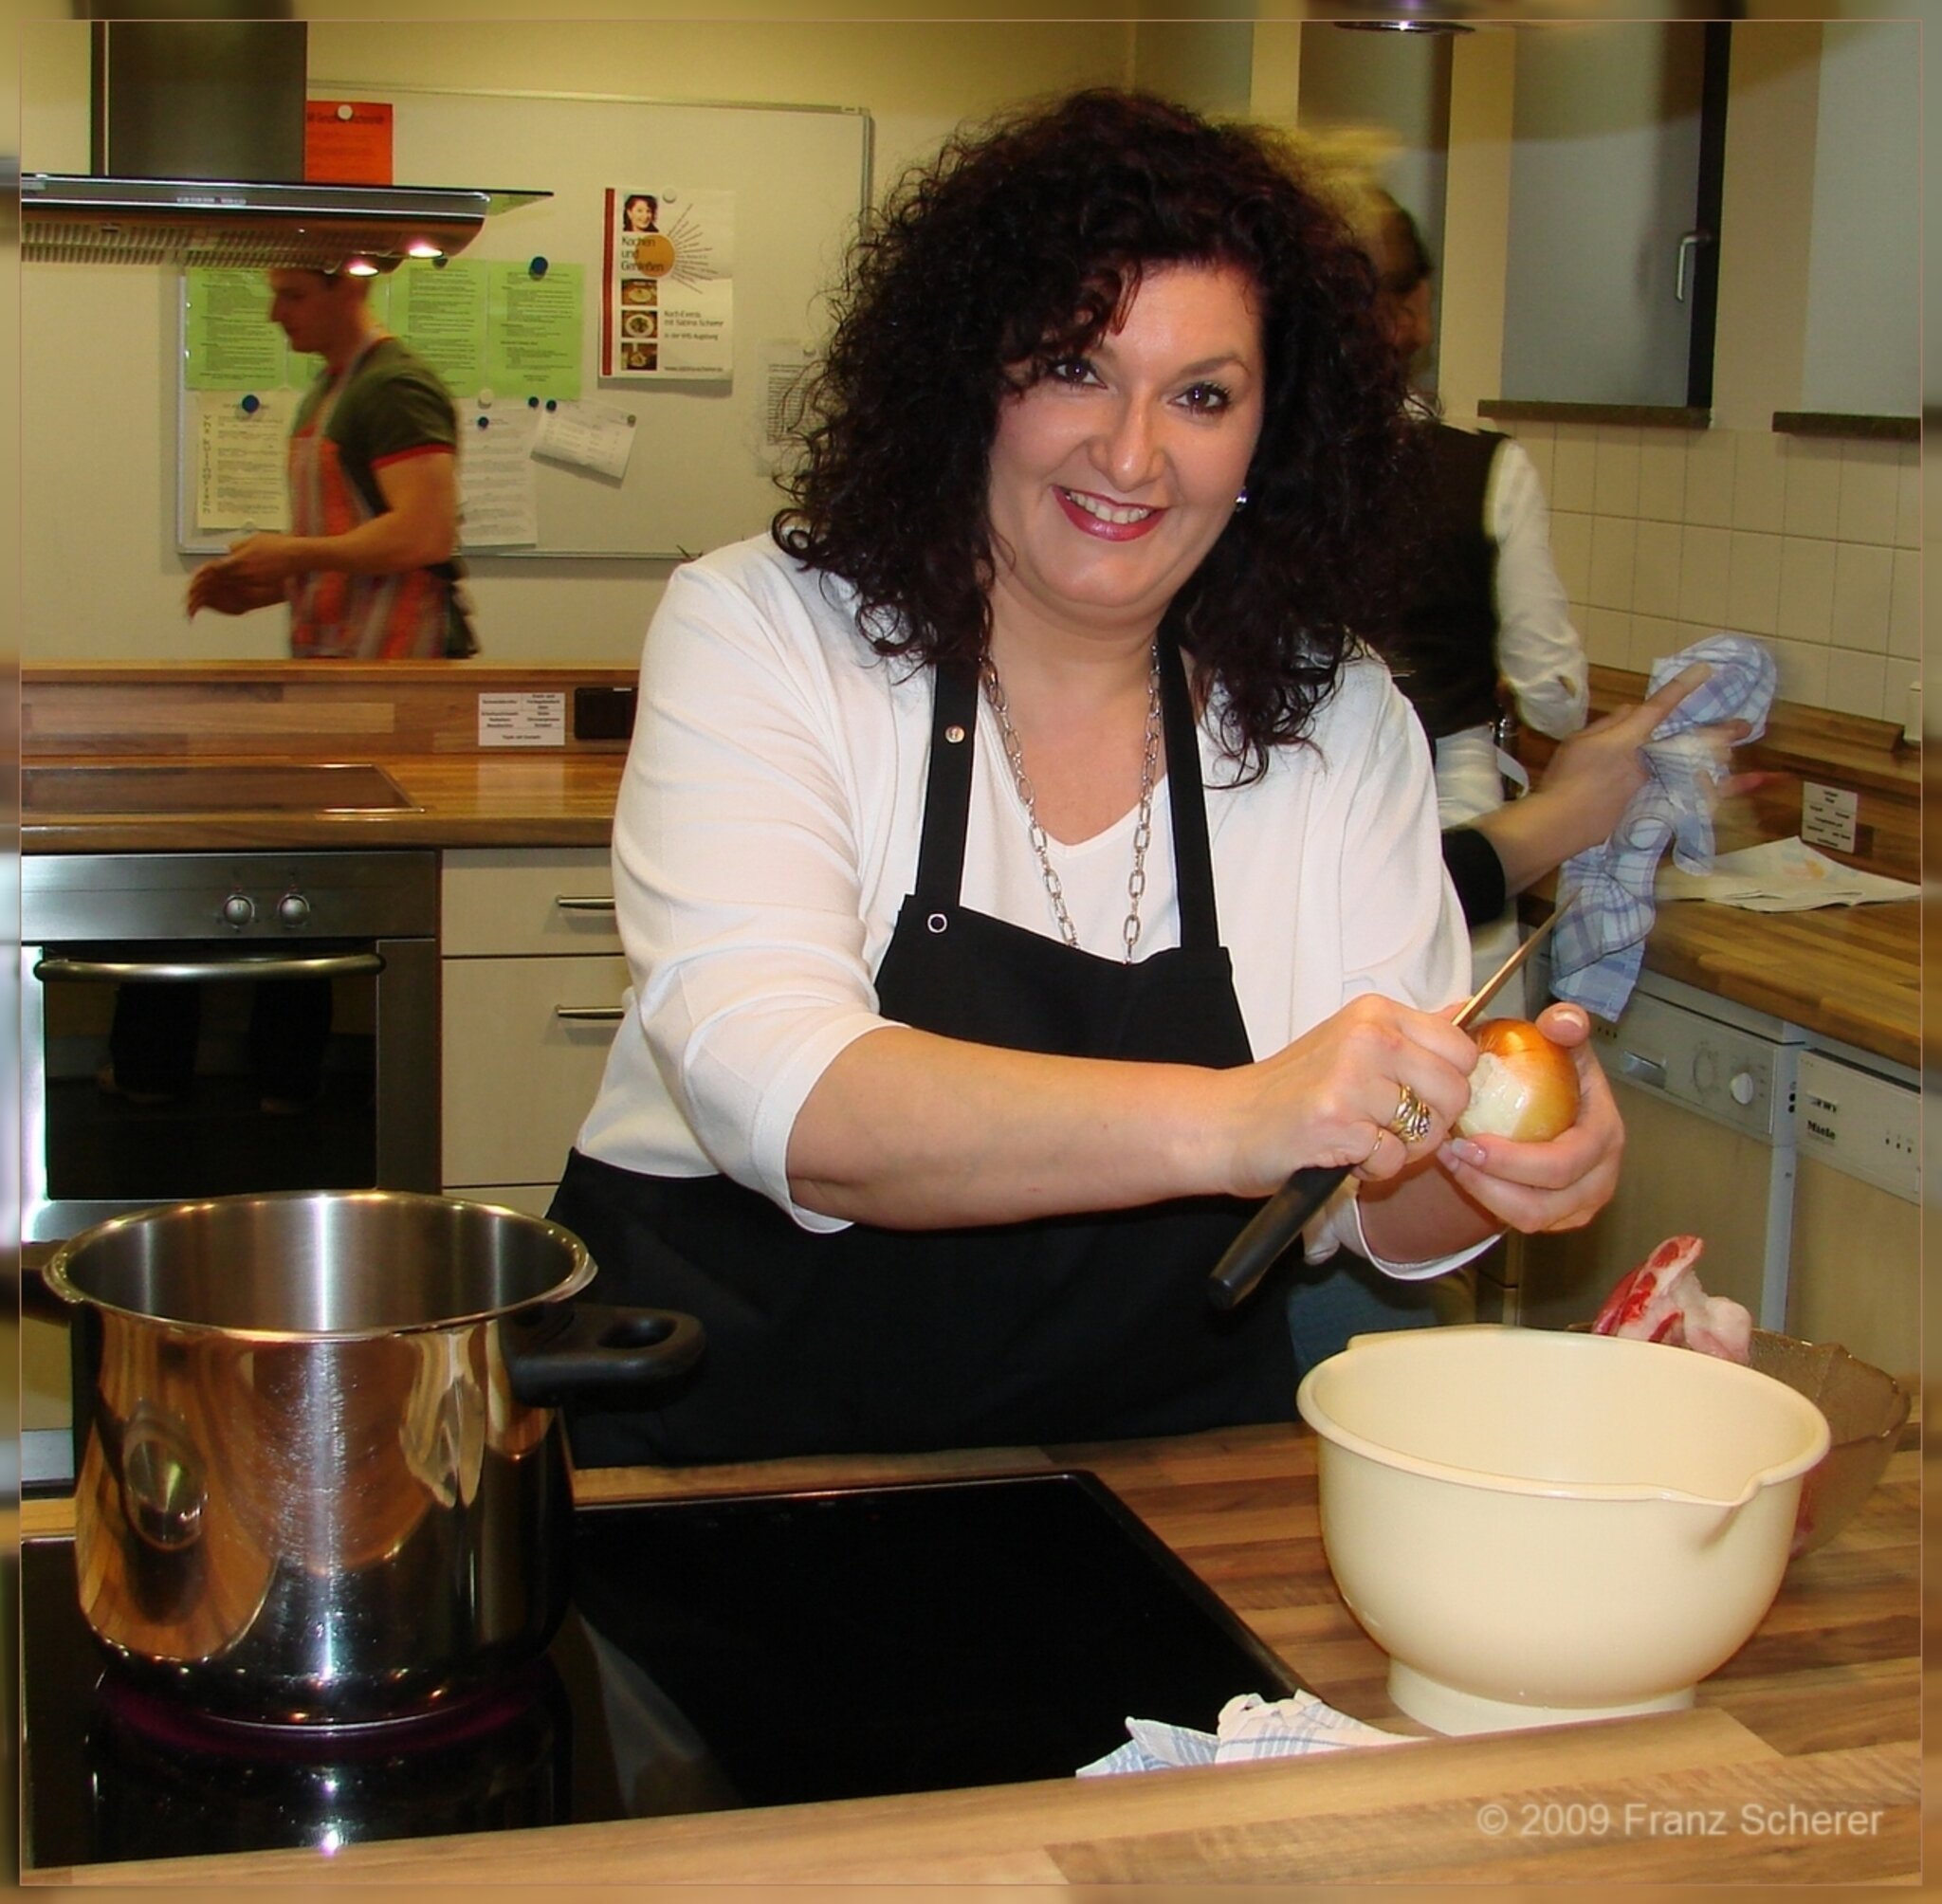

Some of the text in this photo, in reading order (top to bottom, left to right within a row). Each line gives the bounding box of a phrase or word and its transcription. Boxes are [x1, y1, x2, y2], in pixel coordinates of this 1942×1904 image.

[622, 236, 656, 247] Kochen
[622, 249, 639, 259] und
[621, 261, 664, 272] Genießen
[1807, 1120, 1836, 1140] Miele
